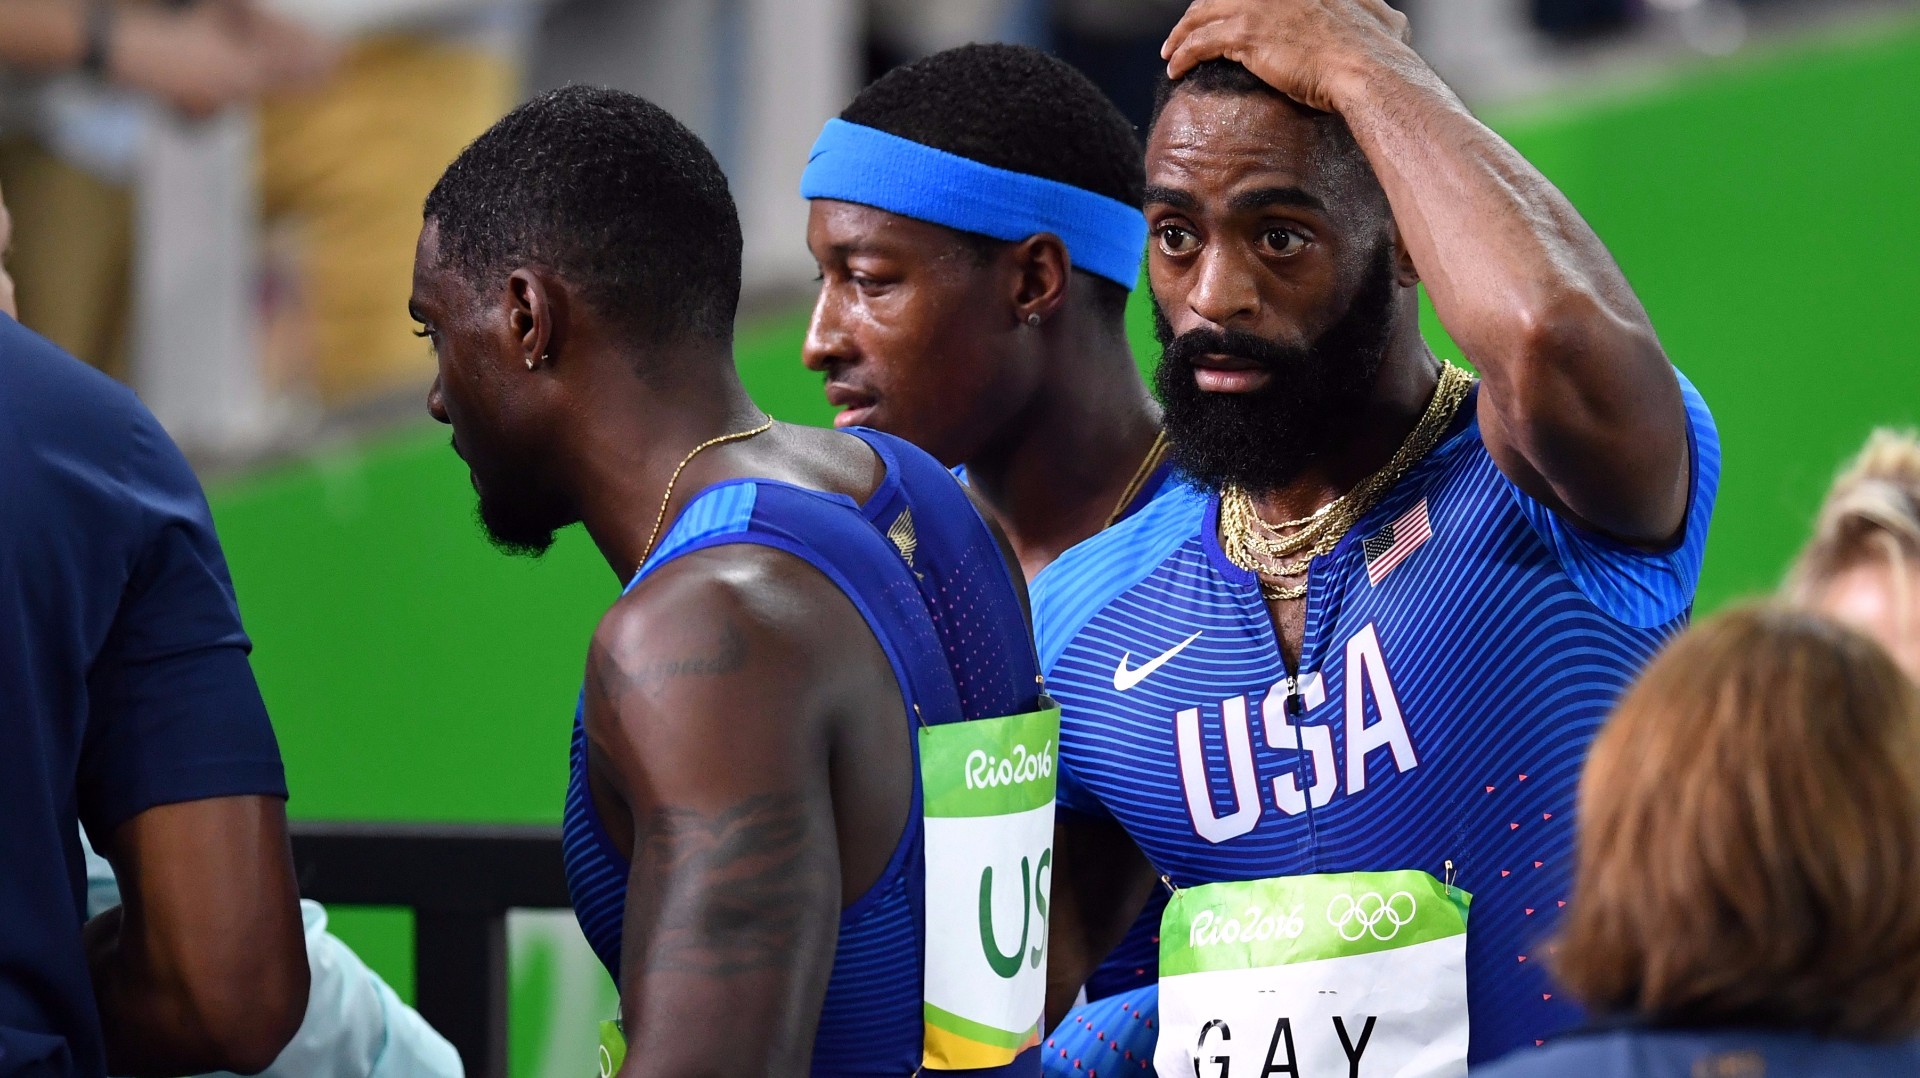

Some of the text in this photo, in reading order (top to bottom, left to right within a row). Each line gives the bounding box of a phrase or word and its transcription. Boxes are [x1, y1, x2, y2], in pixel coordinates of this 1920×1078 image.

[1175, 621, 1419, 844] USA
[978, 848, 1051, 979] US
[1193, 1015, 1378, 1078] GAY
